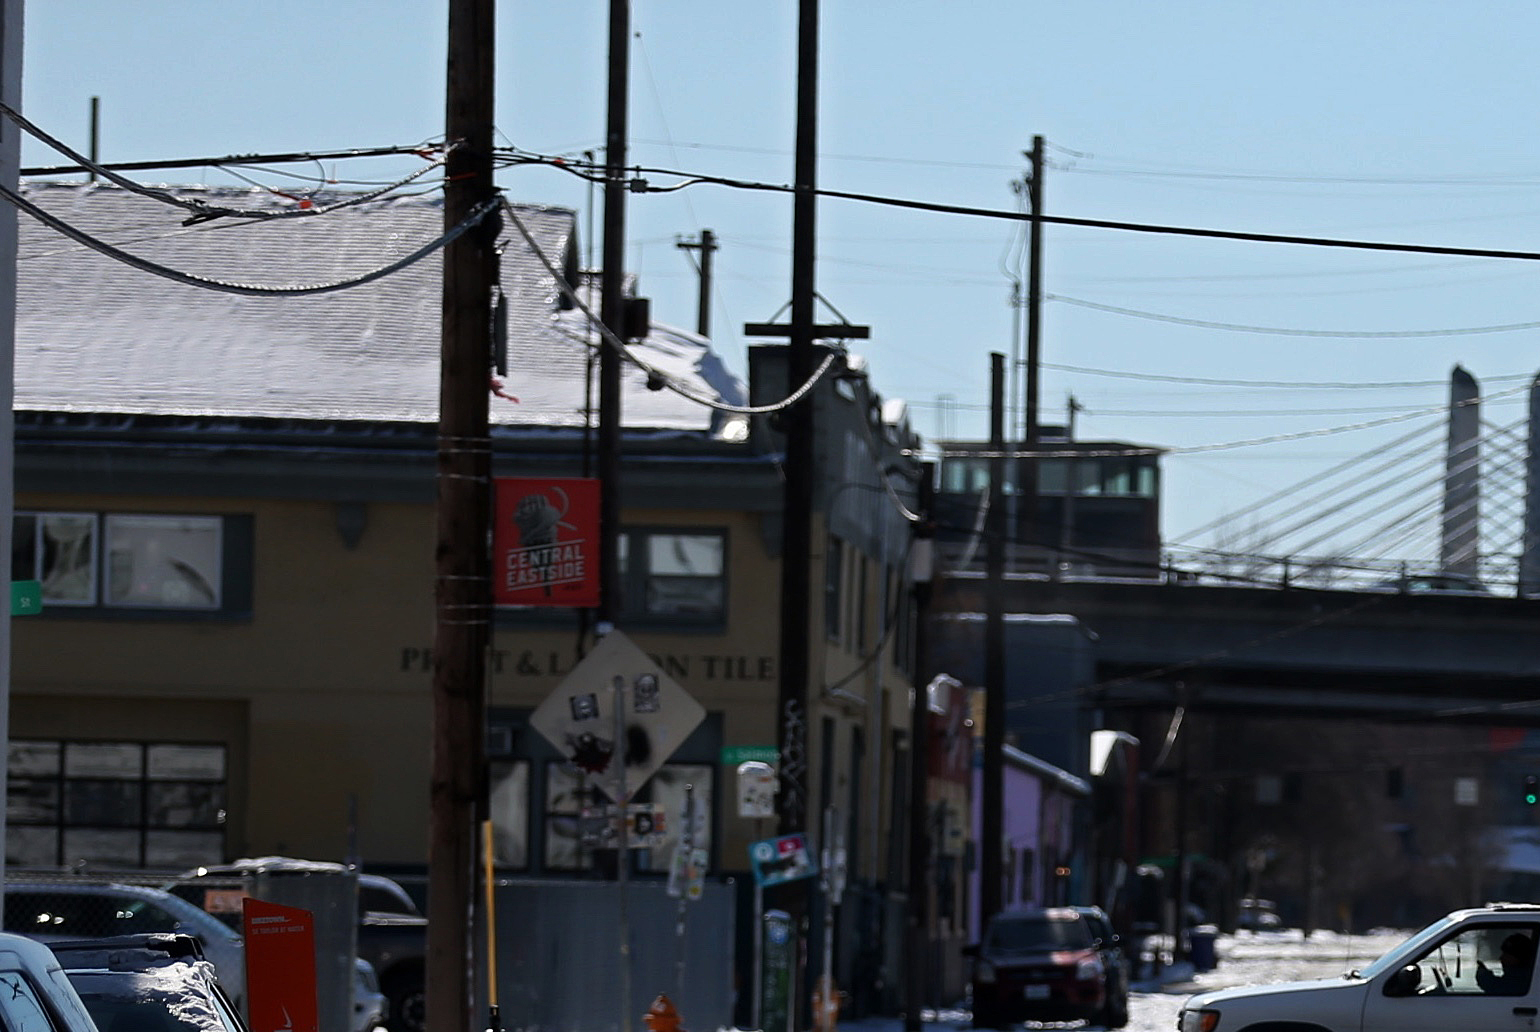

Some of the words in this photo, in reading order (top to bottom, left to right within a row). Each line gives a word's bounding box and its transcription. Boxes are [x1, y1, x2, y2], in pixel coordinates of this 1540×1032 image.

[507, 544, 585, 571] CENTRAL
[507, 561, 585, 587] EASTSIDE
[701, 656, 778, 682] TILE
